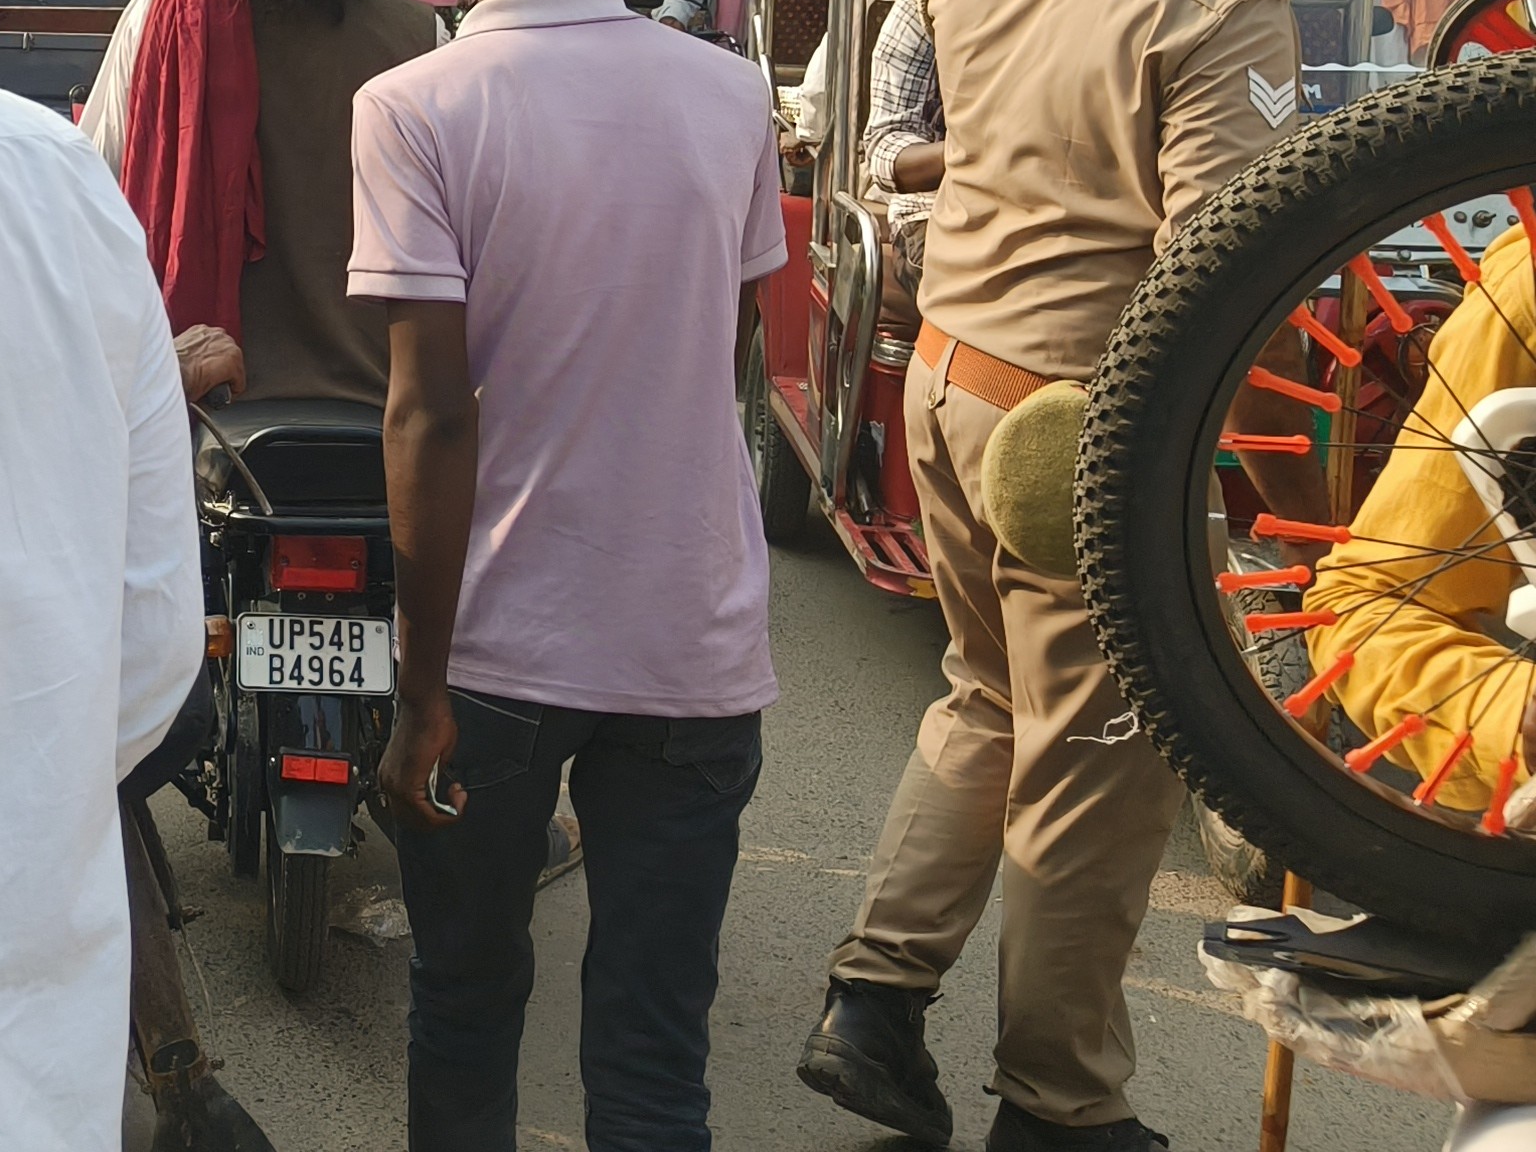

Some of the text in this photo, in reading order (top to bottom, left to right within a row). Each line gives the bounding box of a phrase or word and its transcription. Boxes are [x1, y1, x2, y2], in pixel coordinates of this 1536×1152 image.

[246, 646, 265, 656] IND
[268, 619, 365, 653] UP54B
[268, 654, 365, 688] B4964
